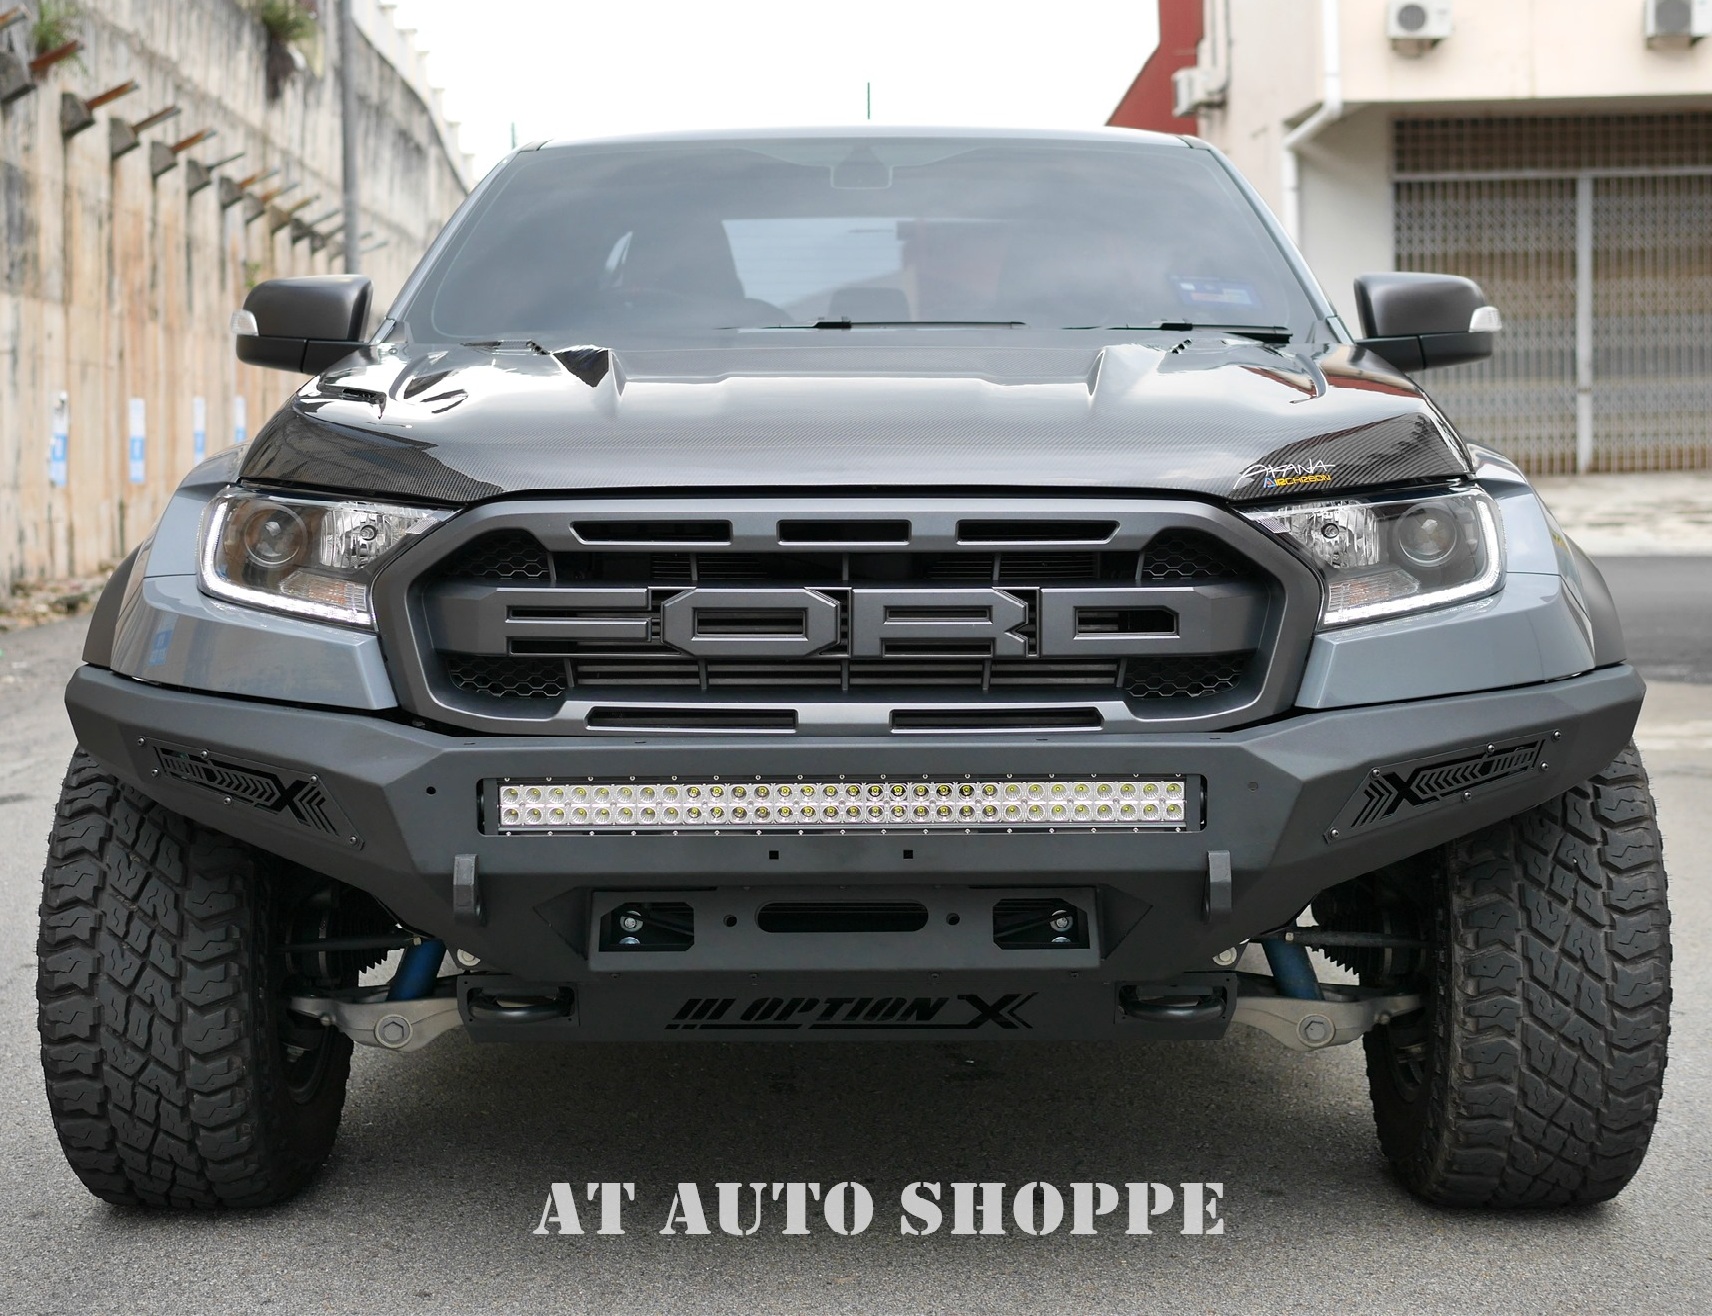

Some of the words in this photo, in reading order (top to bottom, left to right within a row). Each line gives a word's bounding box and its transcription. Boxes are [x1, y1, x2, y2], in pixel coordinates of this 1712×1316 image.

[462, 585, 1220, 658] FORD
[739, 996, 951, 1022] OPTION
[956, 994, 1028, 1030] X
